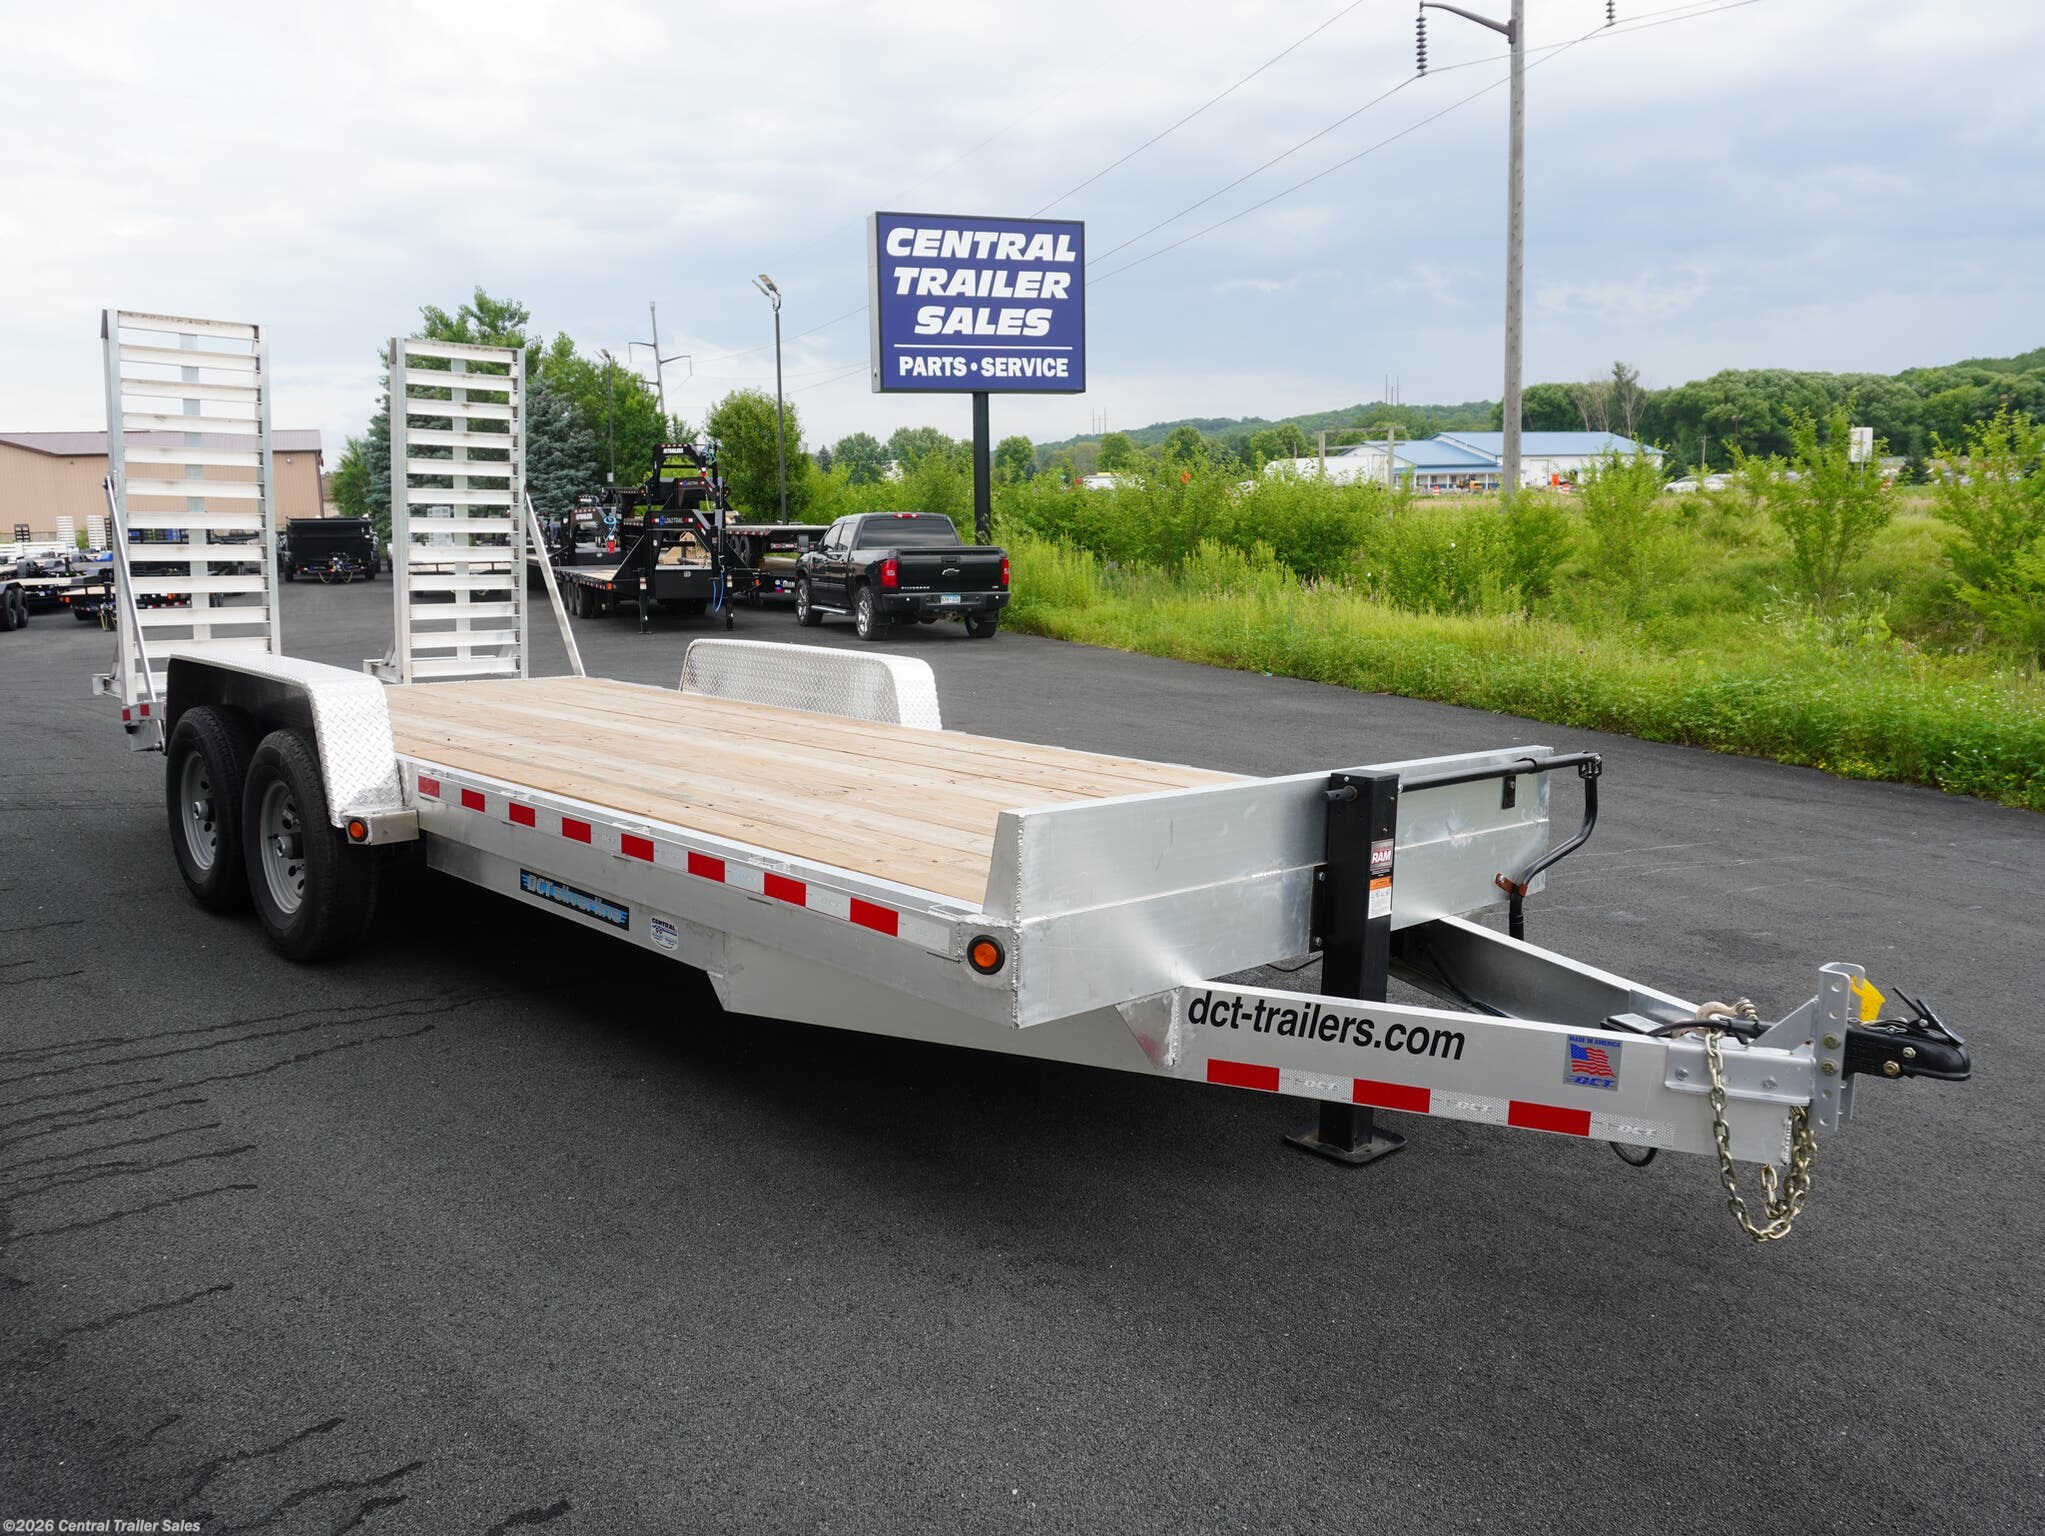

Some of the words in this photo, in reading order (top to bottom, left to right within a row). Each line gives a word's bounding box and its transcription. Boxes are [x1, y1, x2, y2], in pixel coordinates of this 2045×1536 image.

[886, 227, 1076, 262] CENTRAL
[893, 266, 1071, 299] TRAILER
[914, 305, 1053, 337] SALES
[899, 356, 967, 377] PARTS
[981, 357, 1069, 378] SERVICE
[1371, 850, 1392, 864] RAM
[652, 917, 675, 931] CENTRAL
[1188, 991, 1466, 1061] dct-trailers.com
